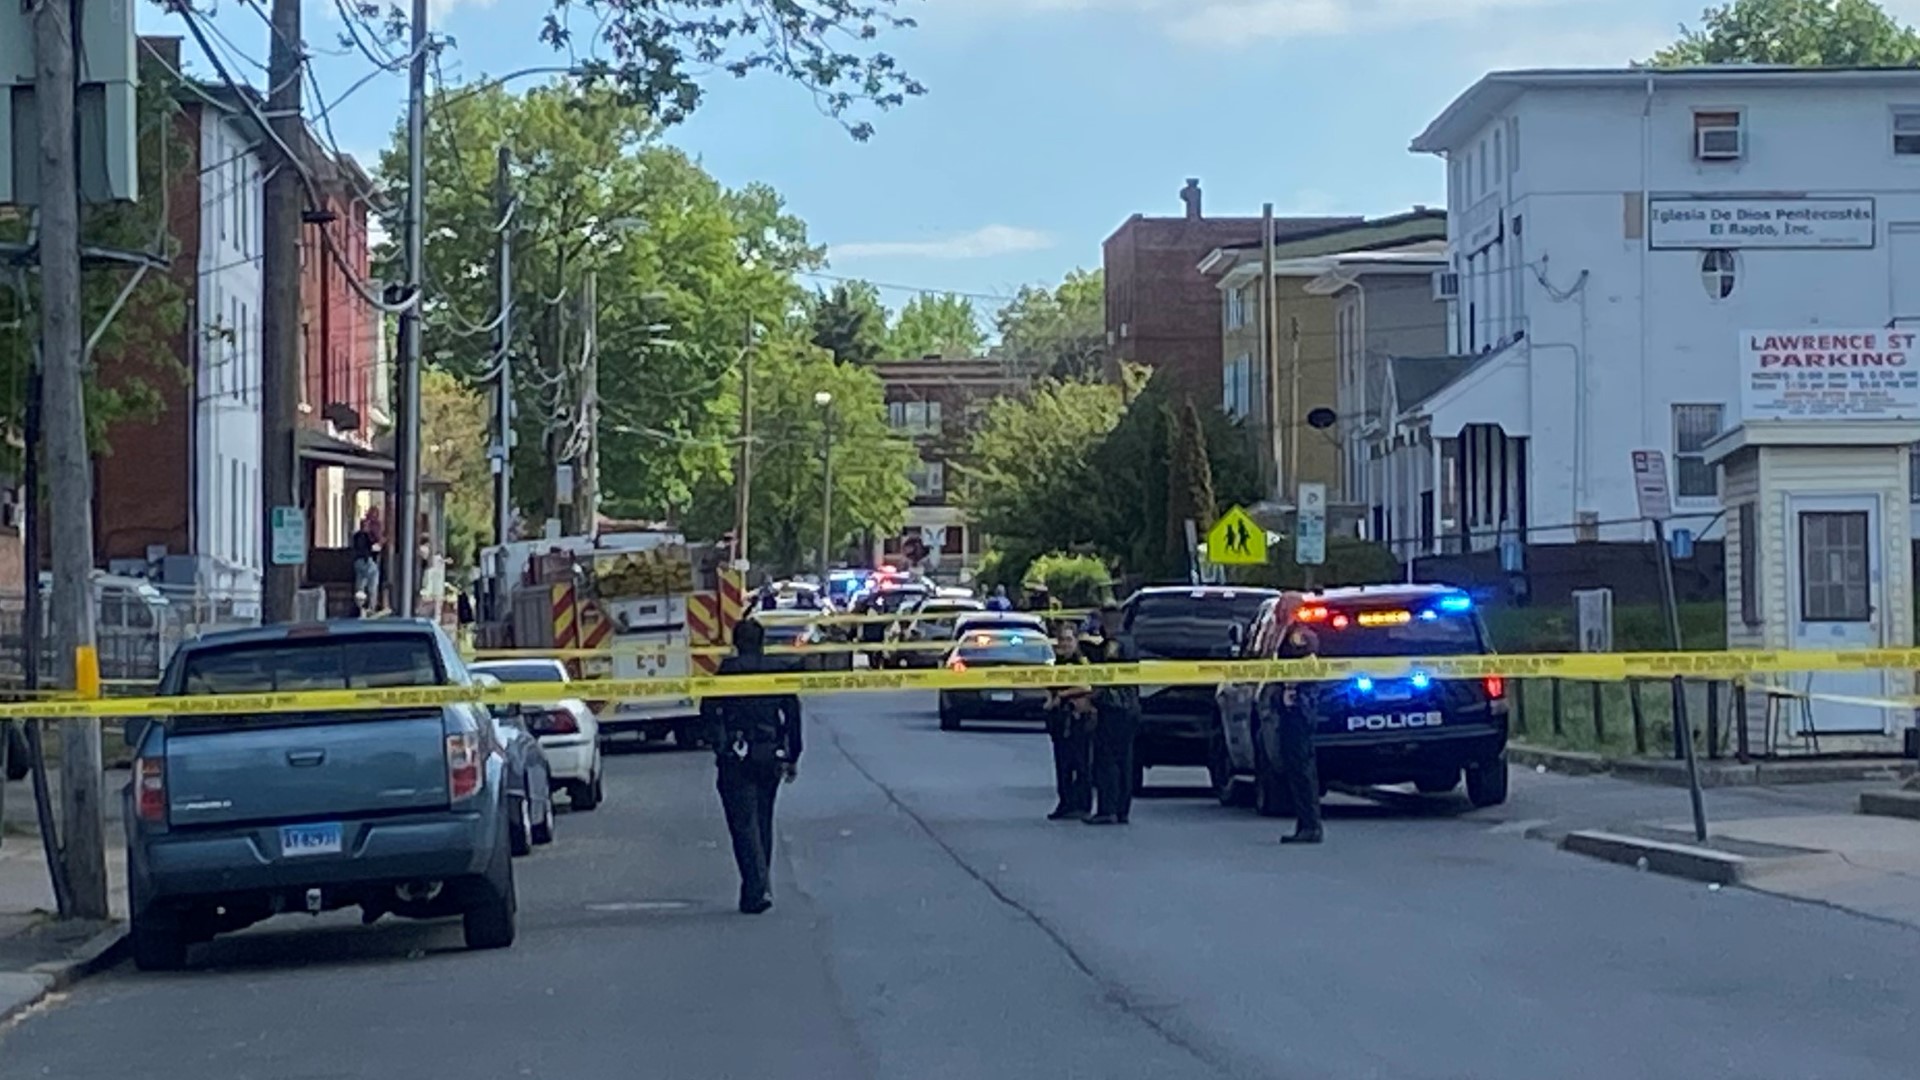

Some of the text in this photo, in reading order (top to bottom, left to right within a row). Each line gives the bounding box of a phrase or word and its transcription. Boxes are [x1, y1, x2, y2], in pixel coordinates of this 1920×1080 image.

[1652, 208, 1706, 224] Iglesia
[1711, 209, 1732, 221] De
[1737, 208, 1771, 221] Dios
[1709, 223, 1724, 235] El
[1783, 222, 1814, 235] Inc.
[1750, 333, 1917, 352] LAWRENCE ST
[1760, 352, 1908, 368] PARKING
[1346, 710, 1443, 731] POLICE
